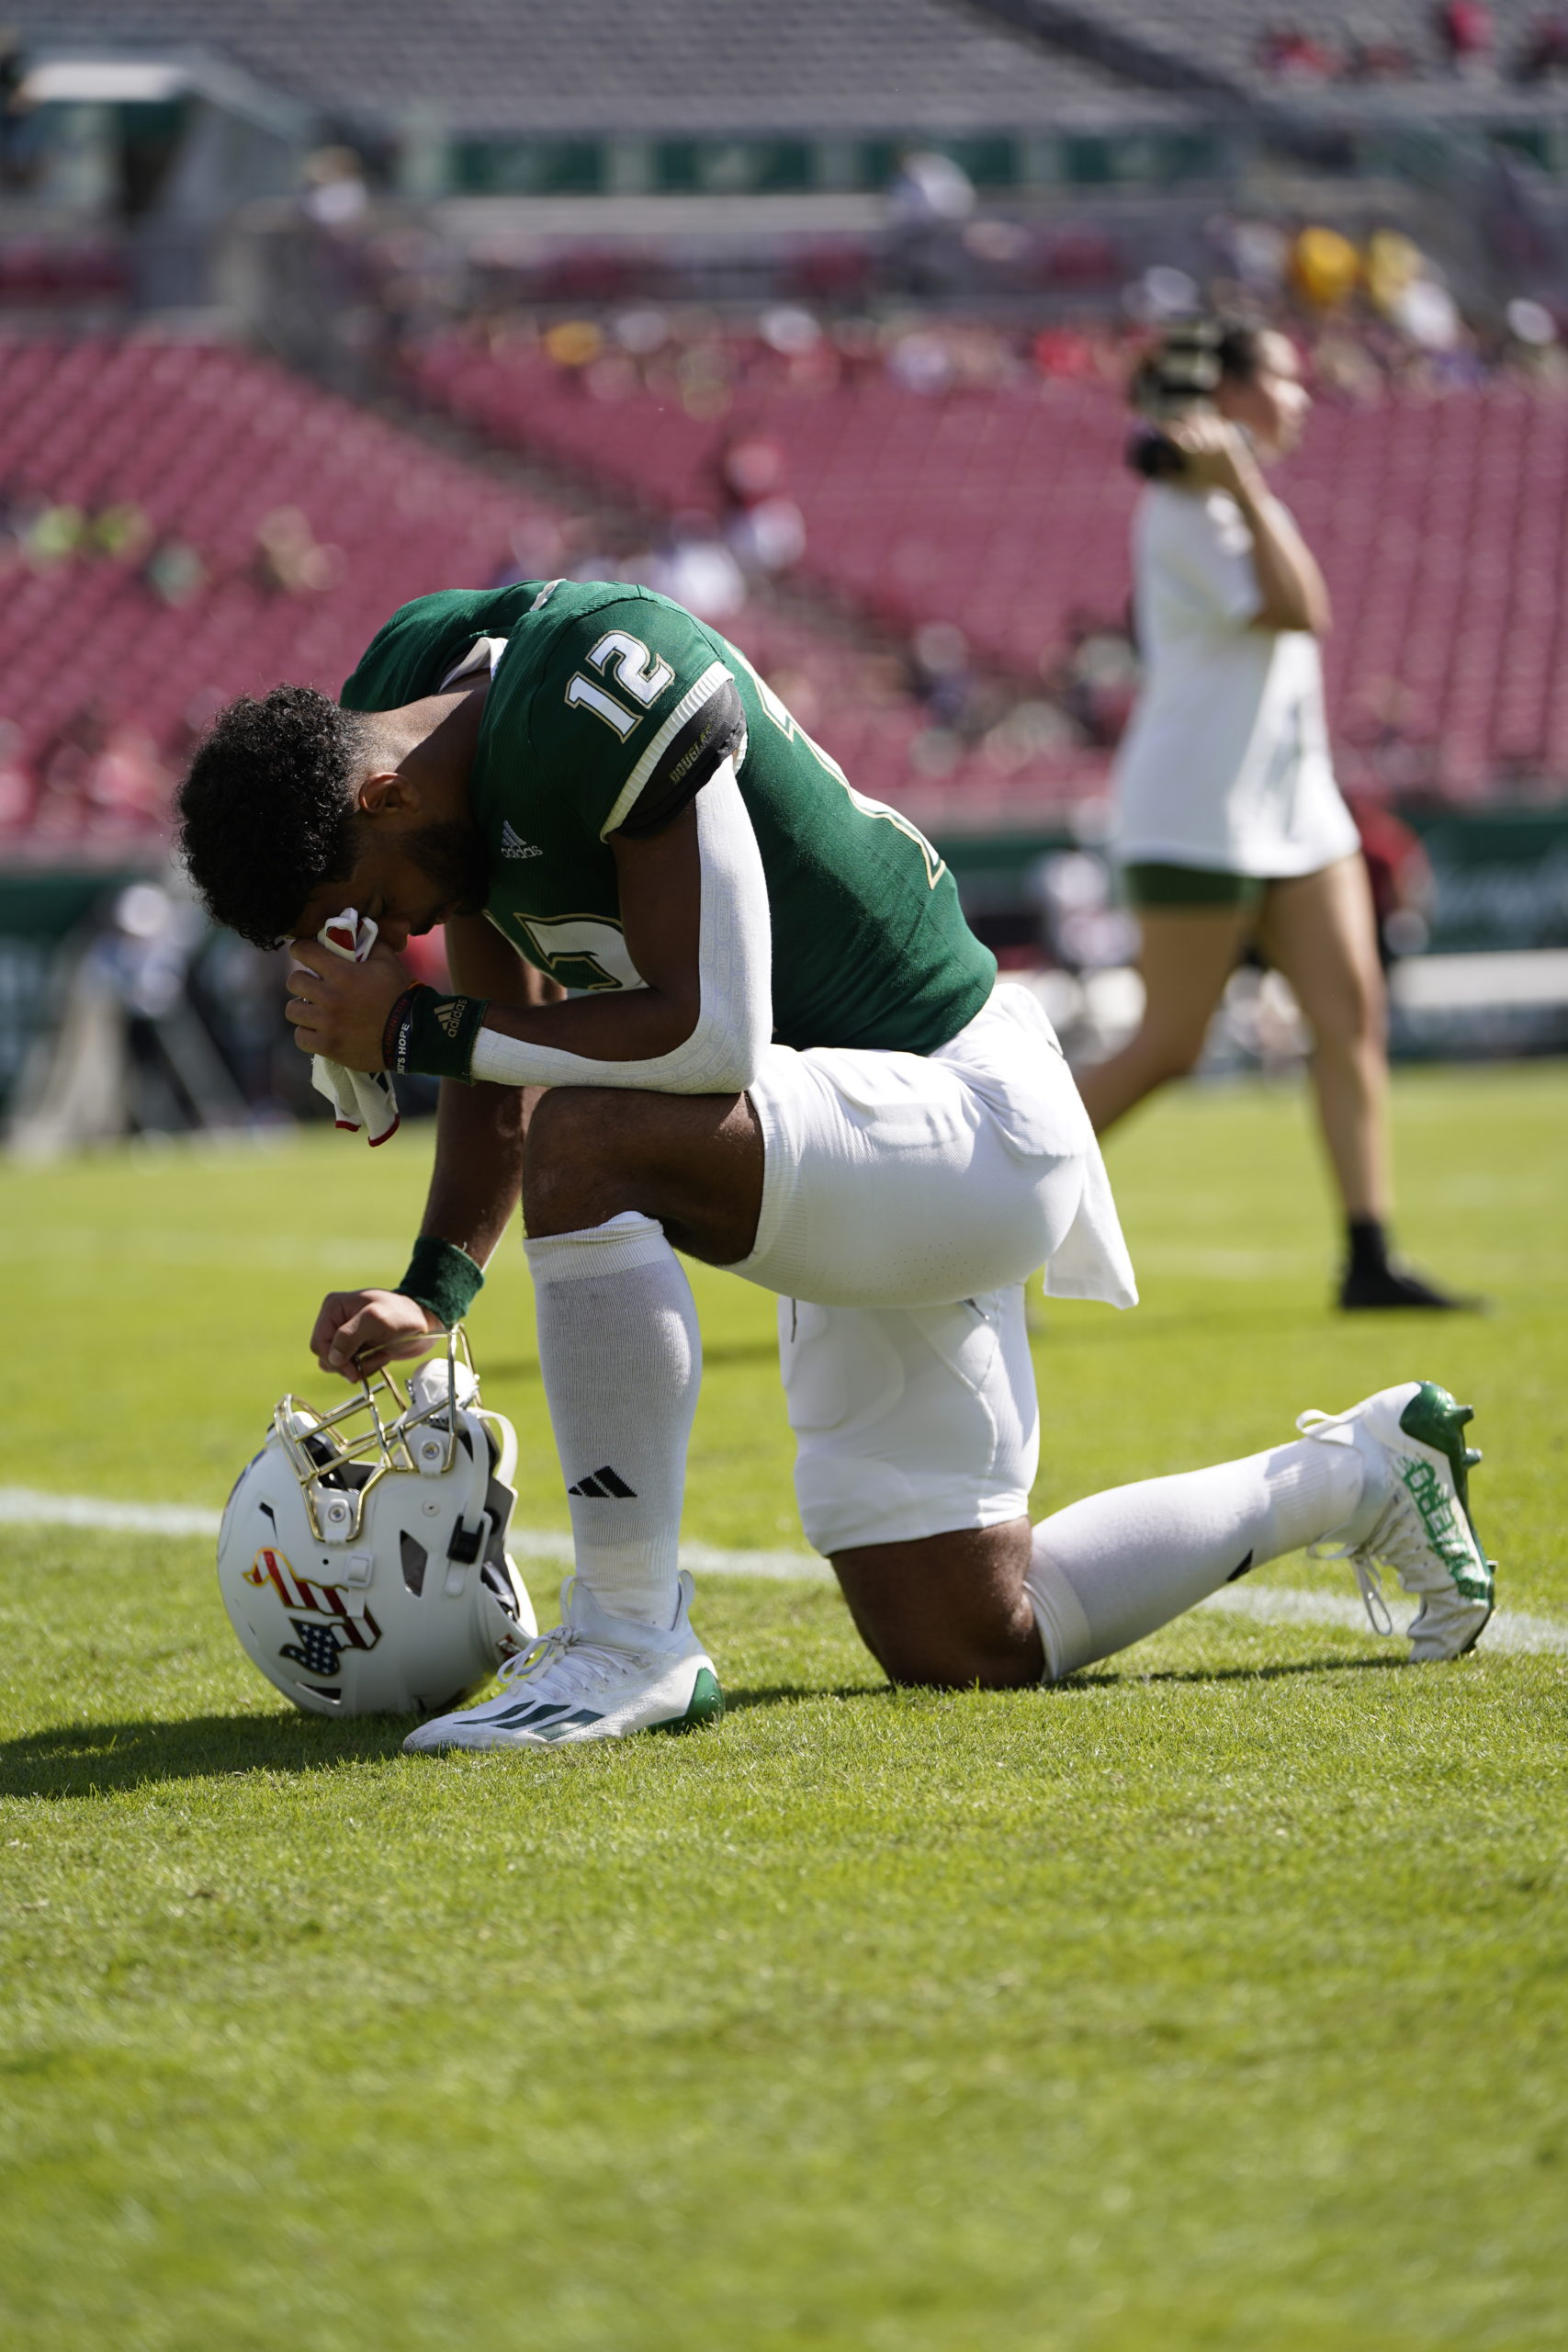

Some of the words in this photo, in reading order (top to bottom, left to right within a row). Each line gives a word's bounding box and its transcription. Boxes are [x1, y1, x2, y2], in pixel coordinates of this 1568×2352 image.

[564, 629, 676, 744] 12
[502, 844, 543, 858] adidas
[448, 1000, 467, 1037] adidas
[399, 1023, 410, 1055] HOPE
